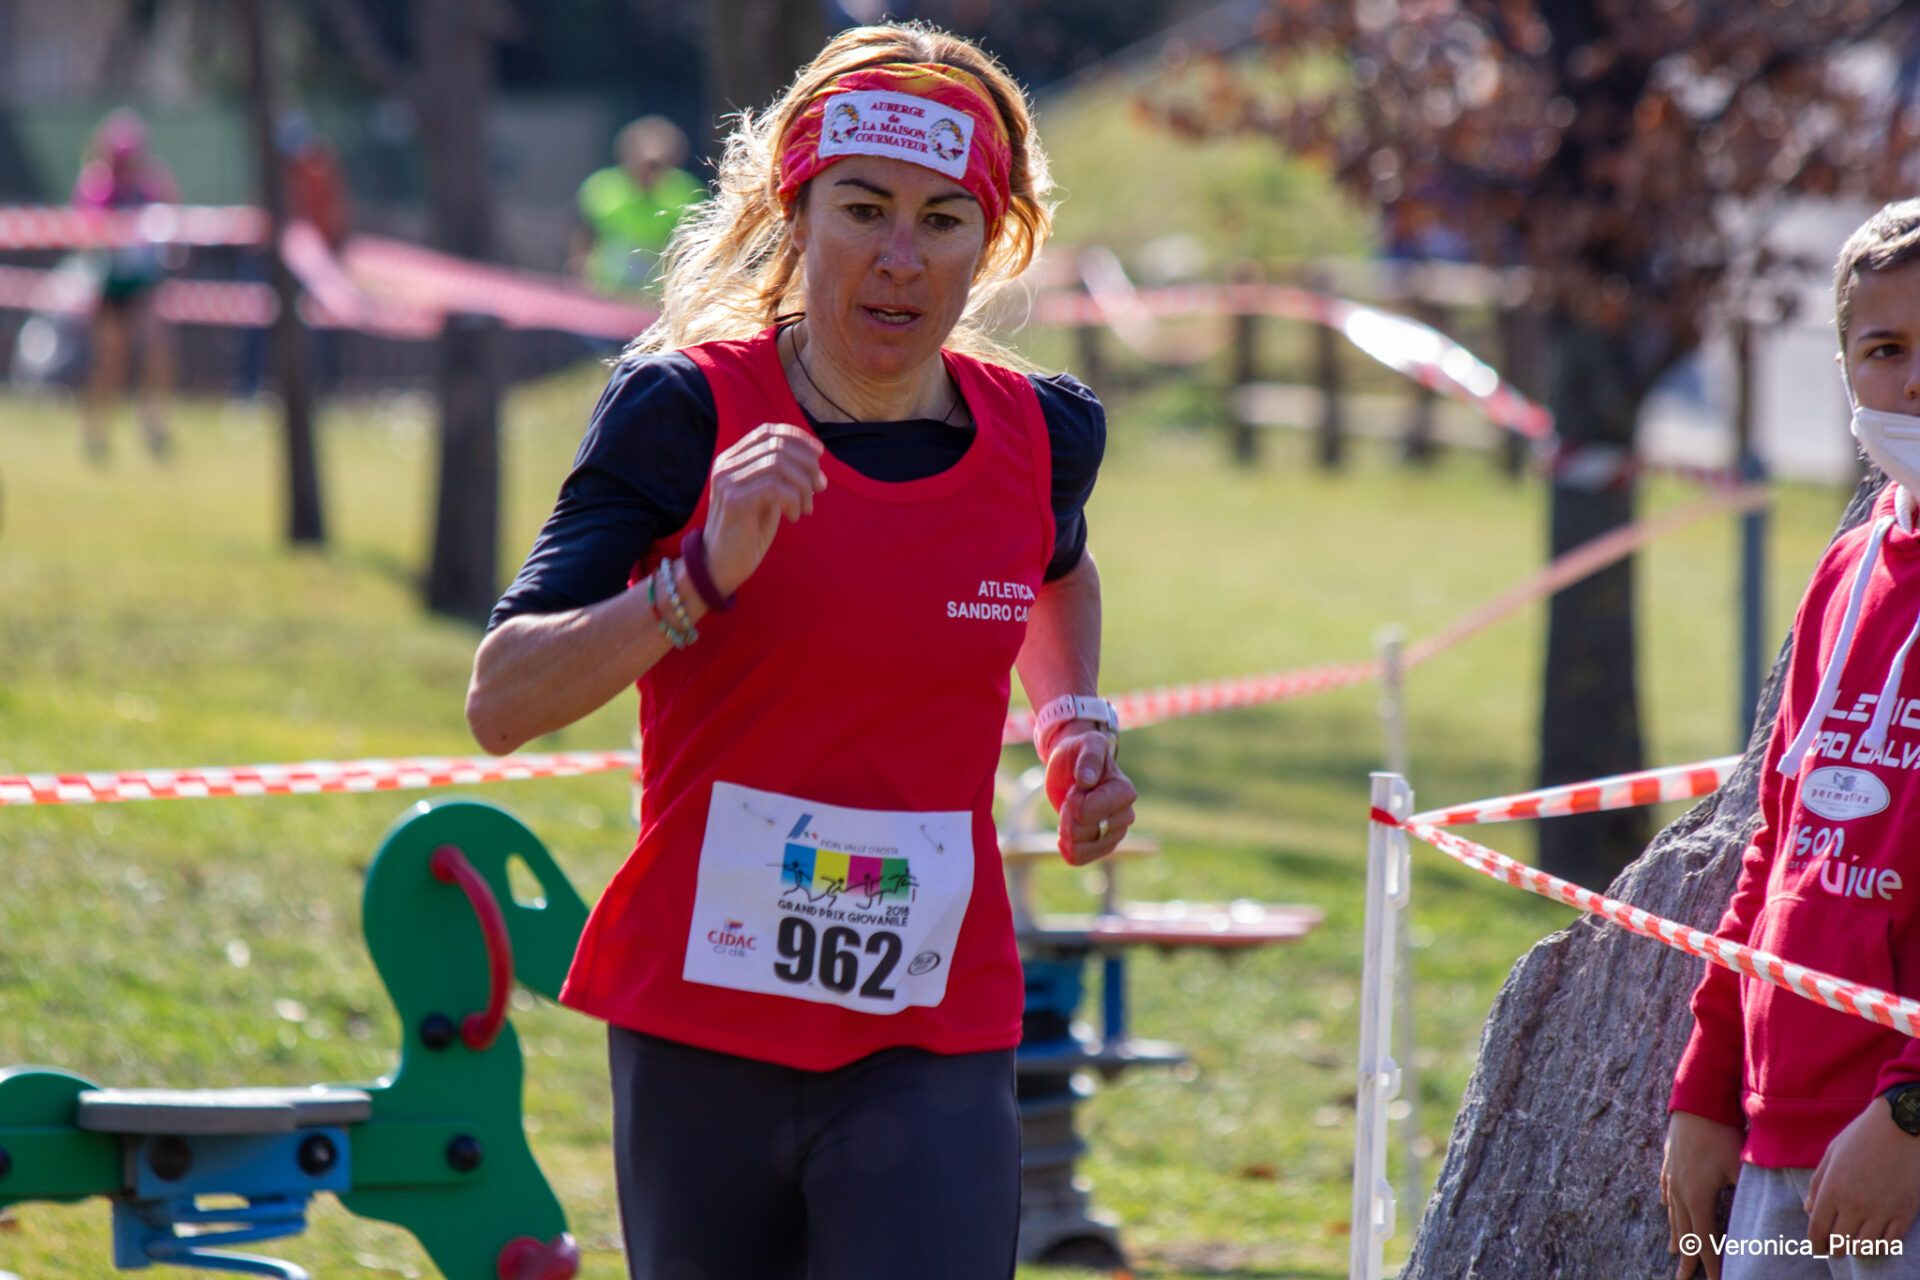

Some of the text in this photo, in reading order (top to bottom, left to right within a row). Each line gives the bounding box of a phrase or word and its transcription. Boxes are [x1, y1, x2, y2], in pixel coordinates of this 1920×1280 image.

[870, 101, 925, 118] AUBERGE
[888, 114, 899, 123] de
[862, 121, 926, 140] LA MAISON
[855, 132, 928, 154] COURMAYEUR
[978, 580, 1036, 600] ATLETICA
[946, 601, 1032, 622] SANDRO CA
[778, 899, 908, 927] GRAND PRIX GIOVANILE
[707, 930, 757, 950] CIDAC
[774, 916, 903, 1000] 962
